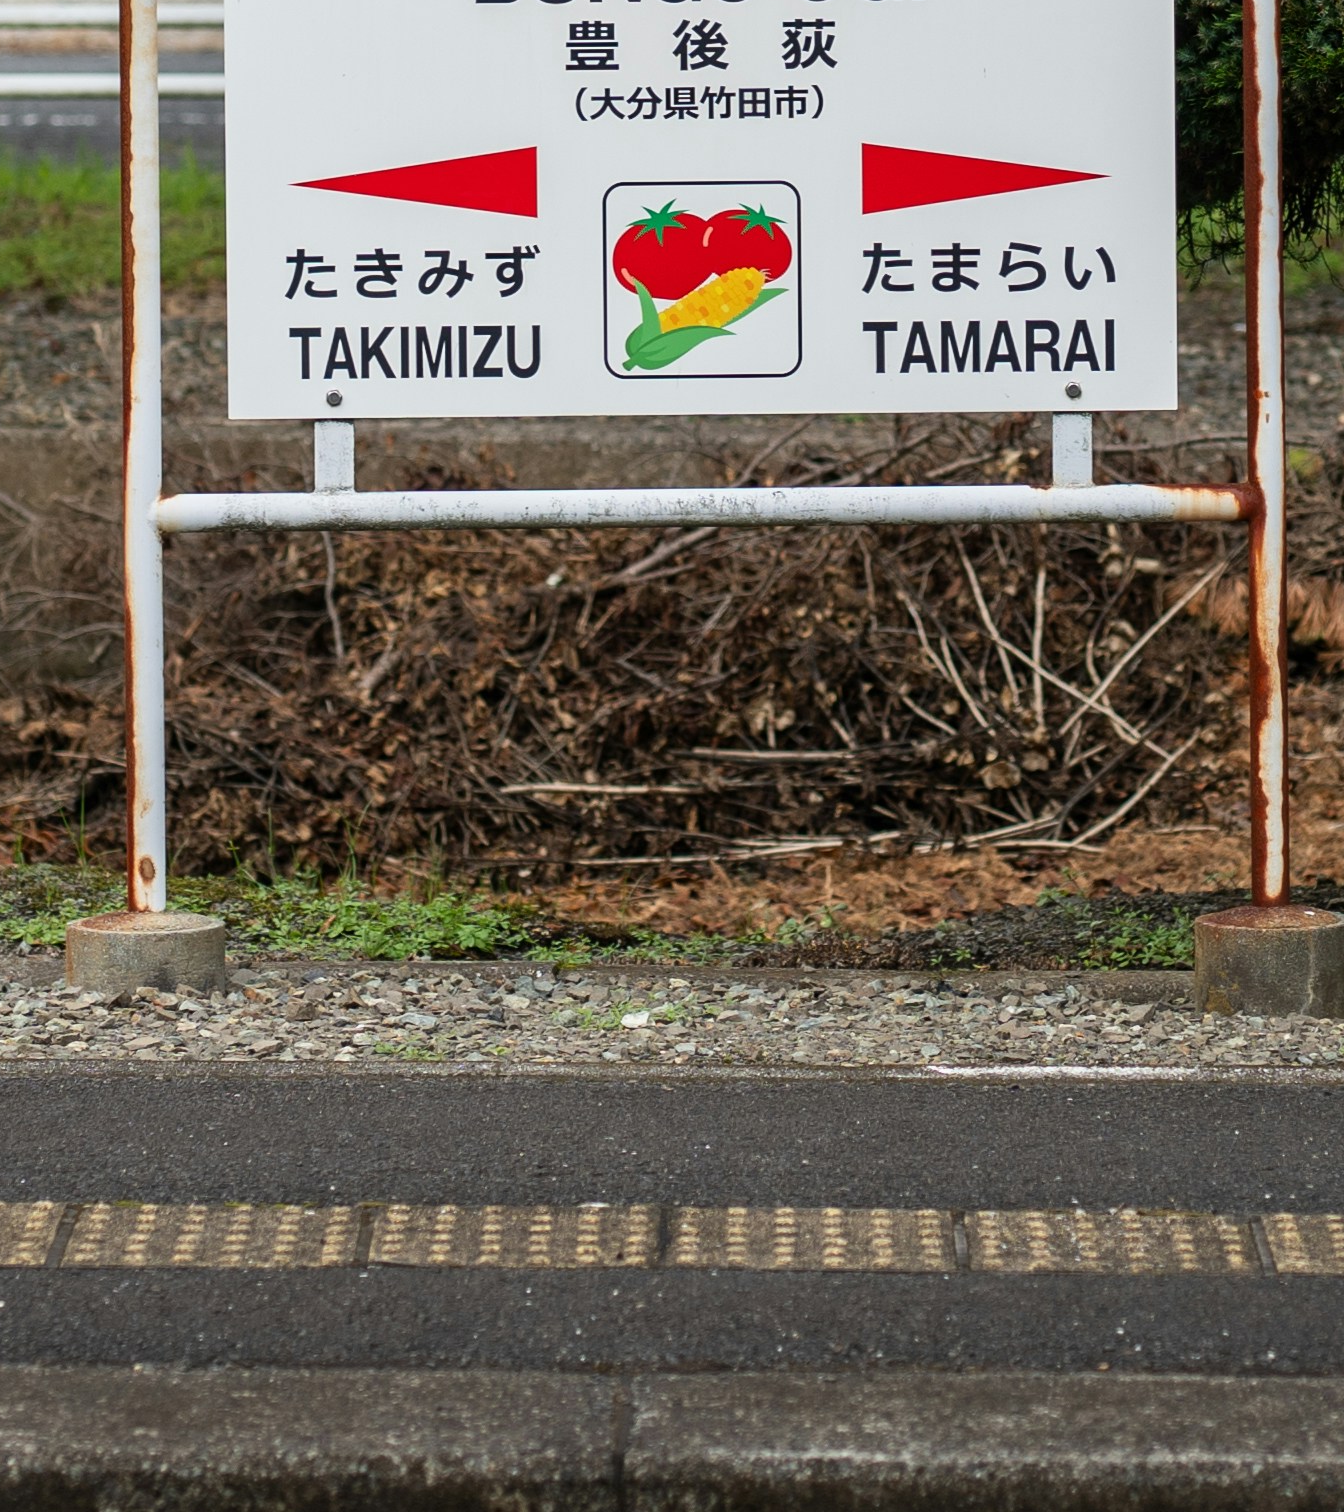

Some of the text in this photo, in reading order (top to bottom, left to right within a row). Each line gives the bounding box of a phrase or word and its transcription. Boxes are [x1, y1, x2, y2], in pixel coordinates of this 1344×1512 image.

[565, 18, 838, 71] 豊後荻
[575, 84, 824, 123] （大分県竹田市）
[284, 244, 542, 300] たきみず
[861, 241, 1117, 294] たまらい
[289, 324, 542, 380] TAKIMIZU
[862, 318, 1116, 374] TAMARAI
